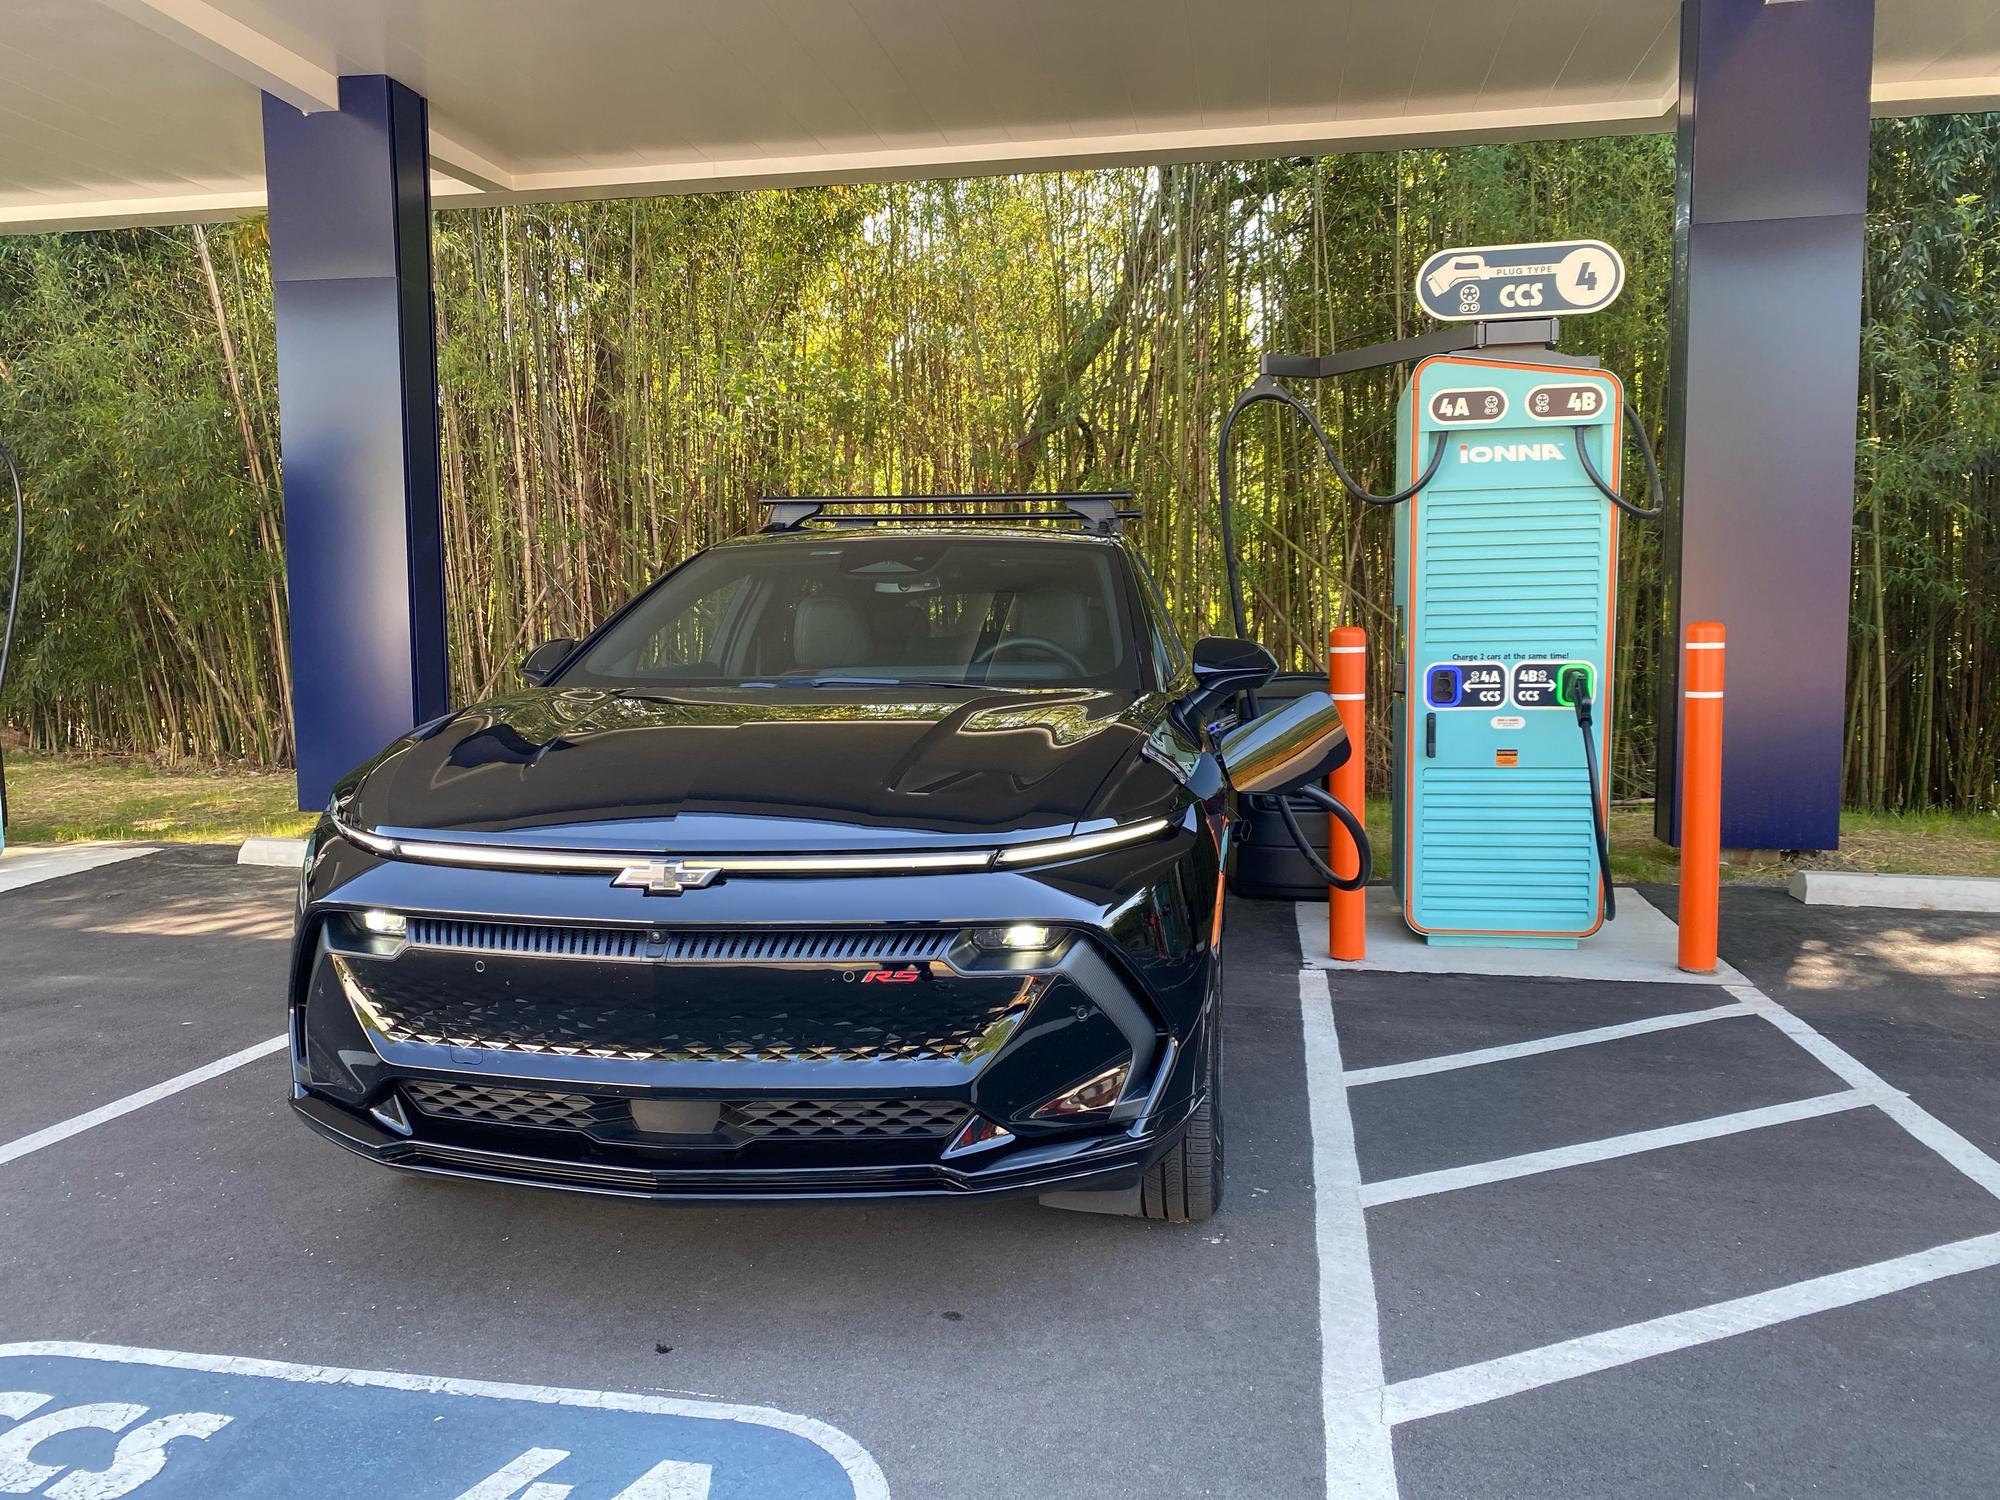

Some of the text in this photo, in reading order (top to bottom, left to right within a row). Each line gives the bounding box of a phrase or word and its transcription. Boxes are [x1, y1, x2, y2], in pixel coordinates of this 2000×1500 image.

[1496, 265, 1553, 276] PLUG TYPE
[1575, 262, 1598, 291] 4
[1500, 282, 1544, 308] CCS
[1439, 397, 1470, 417] 4A
[1567, 392, 1597, 412] 4B
[1452, 653, 1478, 661] Charge
[1480, 670, 1500, 683] 4A
[1519, 669, 1538, 683] 4B
[1479, 691, 1500, 702] CCS
[1518, 690, 1539, 702] CCS
[861, 970, 920, 983] RS
[0, 1391, 236, 1500] CS
